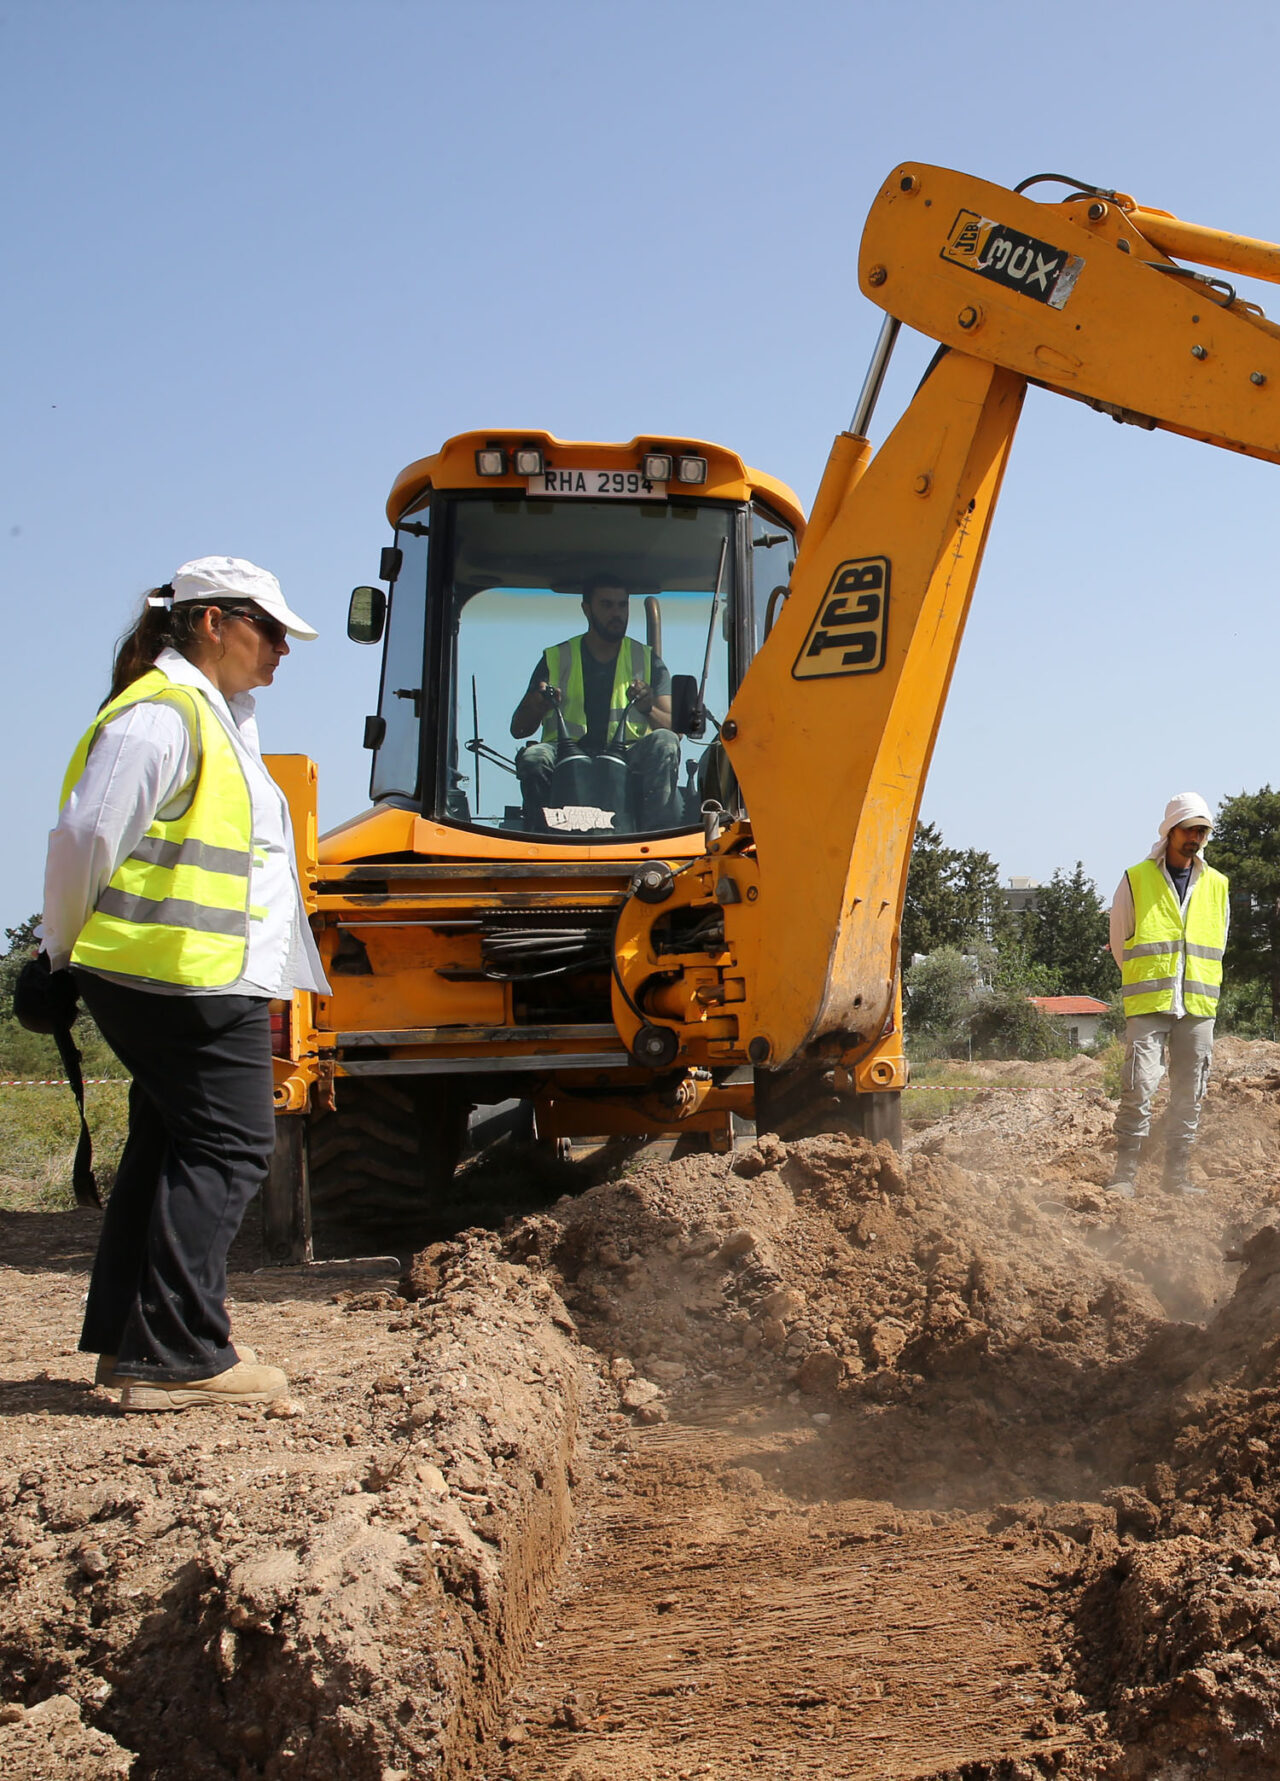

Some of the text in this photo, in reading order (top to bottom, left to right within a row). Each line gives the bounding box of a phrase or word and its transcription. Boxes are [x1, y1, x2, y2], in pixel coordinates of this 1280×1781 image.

[956, 224, 979, 252] JCB
[544, 472, 587, 493] RHA
[806, 565, 883, 665] JCB
